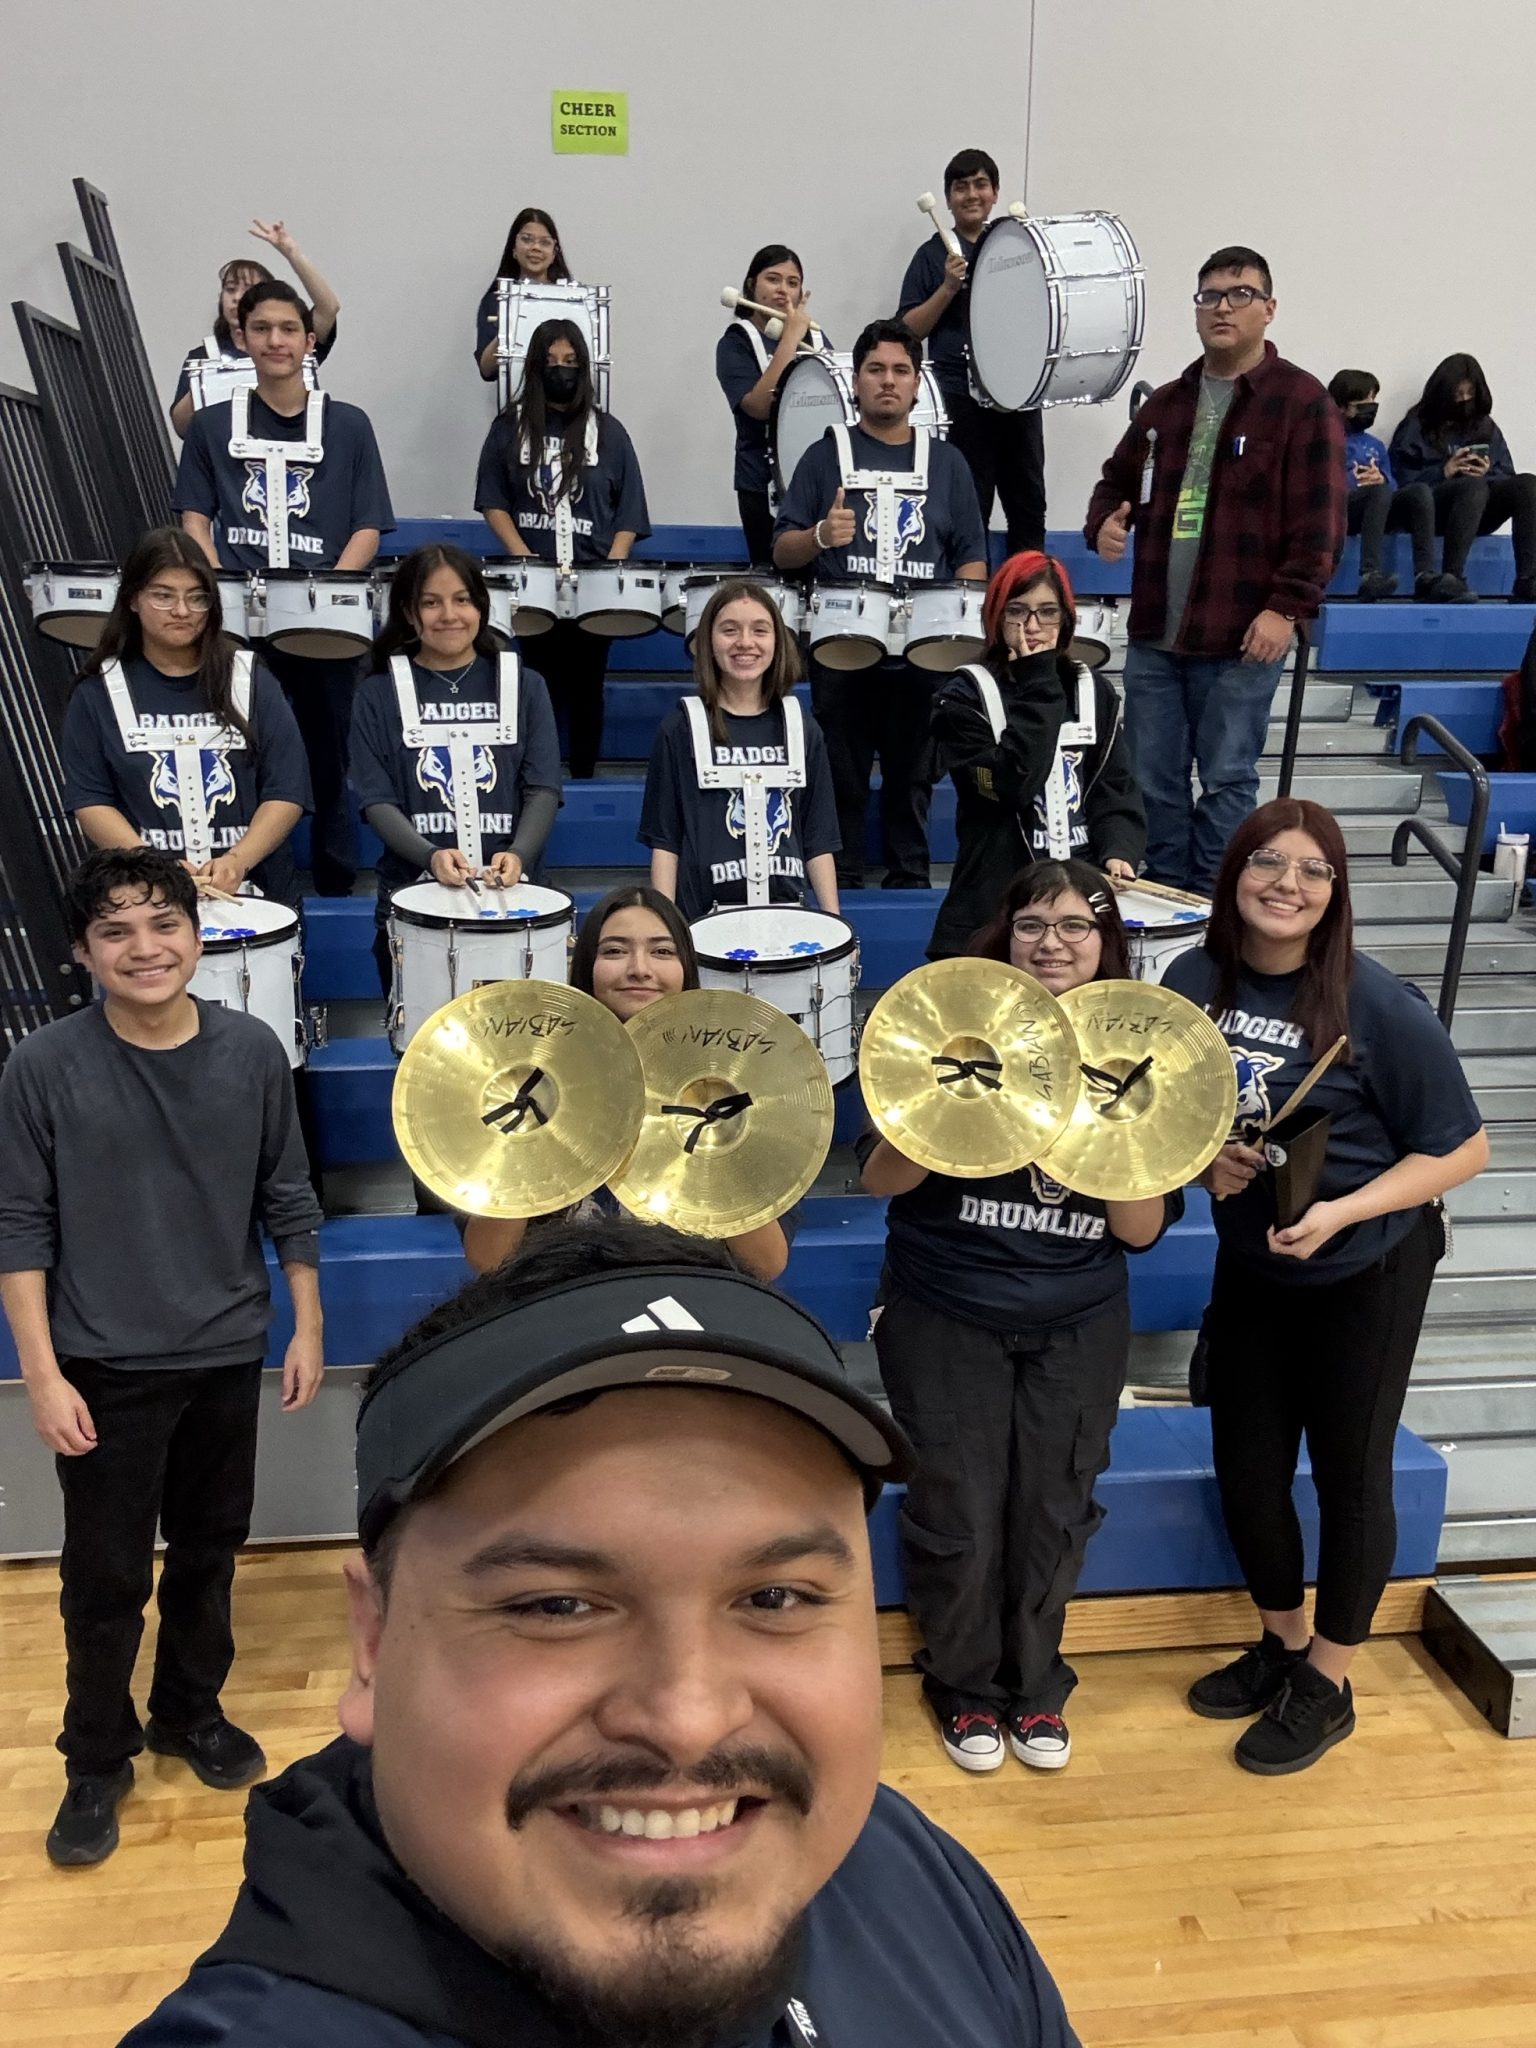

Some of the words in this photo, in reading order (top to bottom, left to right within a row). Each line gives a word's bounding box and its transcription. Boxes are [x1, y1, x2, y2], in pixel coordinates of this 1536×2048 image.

[560, 102, 616, 117] CHEER
[560, 124, 617, 137] SECTION
[228, 526, 323, 554] DRUINE
[847, 555, 935, 579] DRULINE
[139, 712, 218, 729] BADGE
[420, 702, 499, 720] ADGER
[715, 746, 788, 765] BADGE
[484, 1014, 577, 1038] SABIAN
[681, 1025, 777, 1055] SABIAN
[1016, 1020, 1053, 1101] SABIAN
[790, 1997, 818, 2038] NIKE
